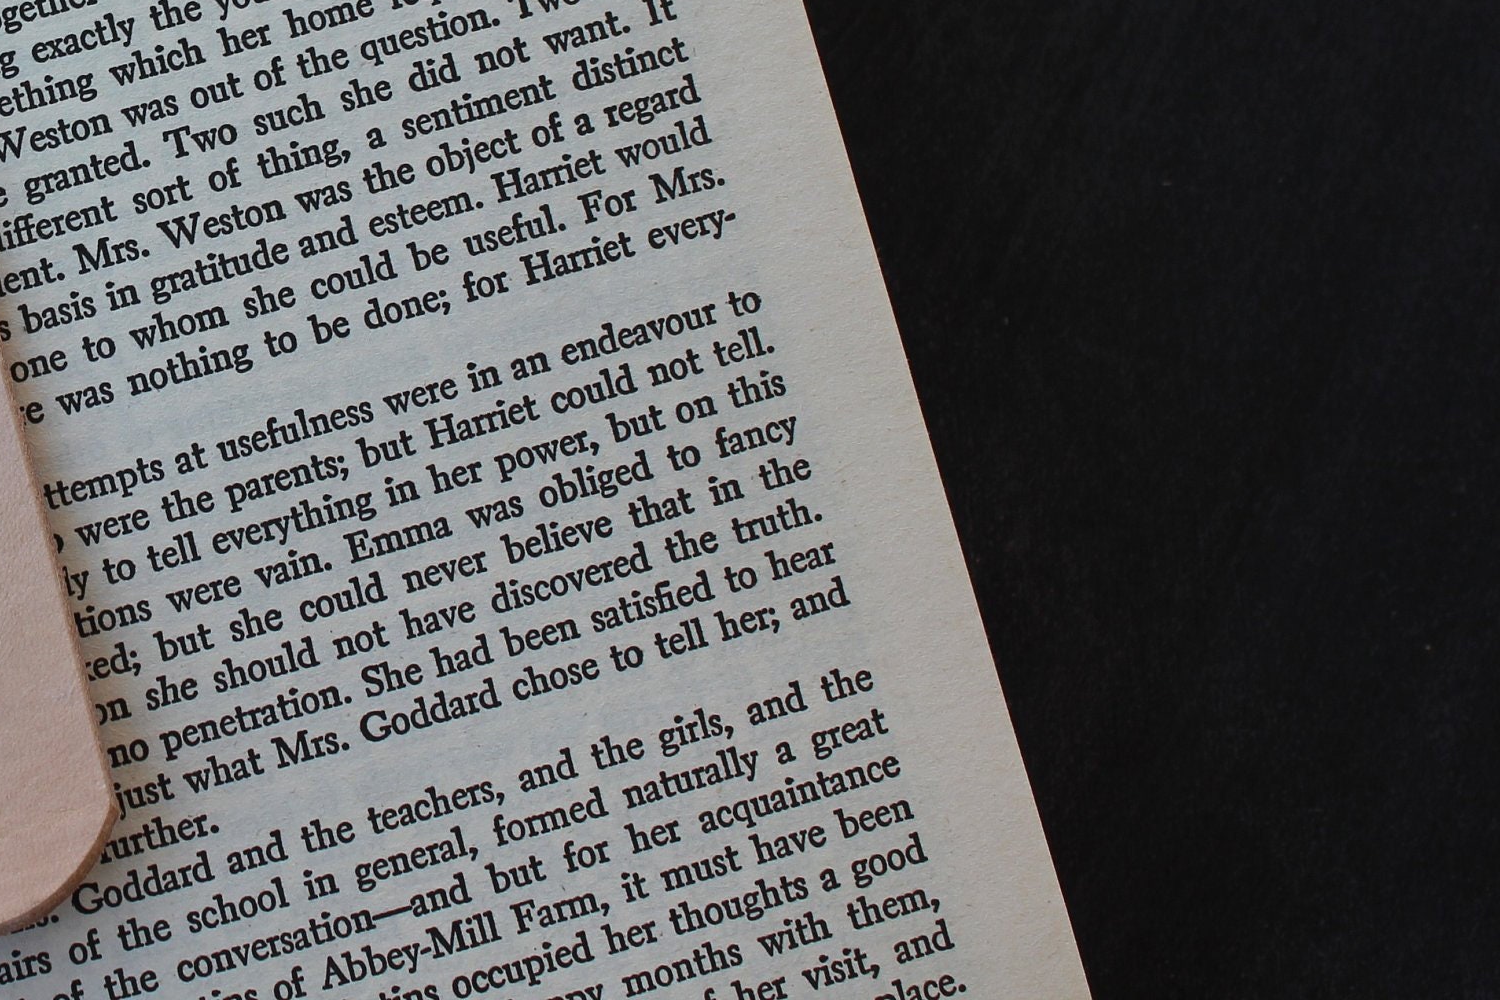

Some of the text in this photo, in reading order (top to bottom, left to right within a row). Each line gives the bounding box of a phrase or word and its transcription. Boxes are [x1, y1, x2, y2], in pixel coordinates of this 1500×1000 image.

[132, 174, 194, 215] sort
[207, 156, 243, 193] of
[256, 138, 352, 180] thing,
[365, 127, 388, 150] a
[401, 74, 557, 140] sentiment
[571, 36, 690, 92] distinct
[10, 165, 726, 383] one to whom she could be useful. For Mrs.
[108, 541, 837, 768] no penetration. She had been satisfied to hear
[114, 575, 852, 819] just what Mrs. Goddard chose to tell her; and
[68, 927, 103, 966] of
[116, 917, 173, 952] the
[186, 876, 291, 934] school
[302, 869, 341, 901] in
[354, 825, 479, 893] general,
[492, 785, 610, 848] formed
[621, 745, 759, 810] naturally
[774, 741, 797, 766] a
[810, 708, 890, 761] great
